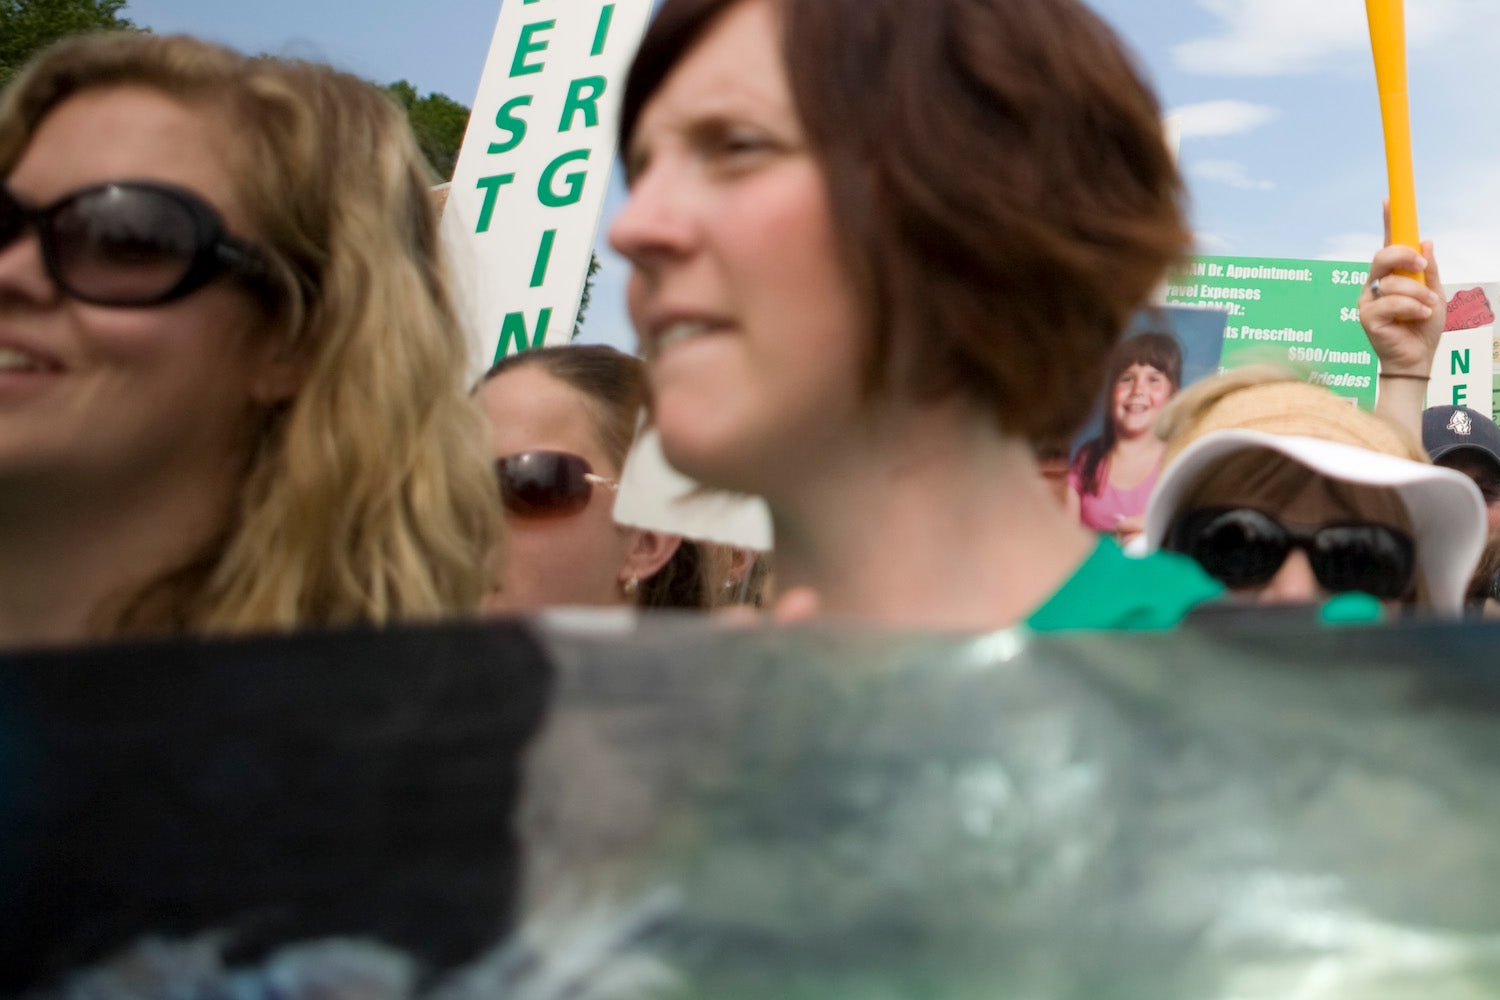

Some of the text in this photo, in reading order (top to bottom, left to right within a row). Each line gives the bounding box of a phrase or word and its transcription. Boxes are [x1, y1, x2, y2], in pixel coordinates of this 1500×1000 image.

[1208, 264, 1225, 277] Dr.
[1226, 264, 1313, 281] Appointment:
[1166, 285, 1261, 300] ravel Expenses
[1241, 326, 1312, 342] Prescribed
[1288, 347, 1371, 364] $500/month
[1308, 372, 1371, 387] Priceless
